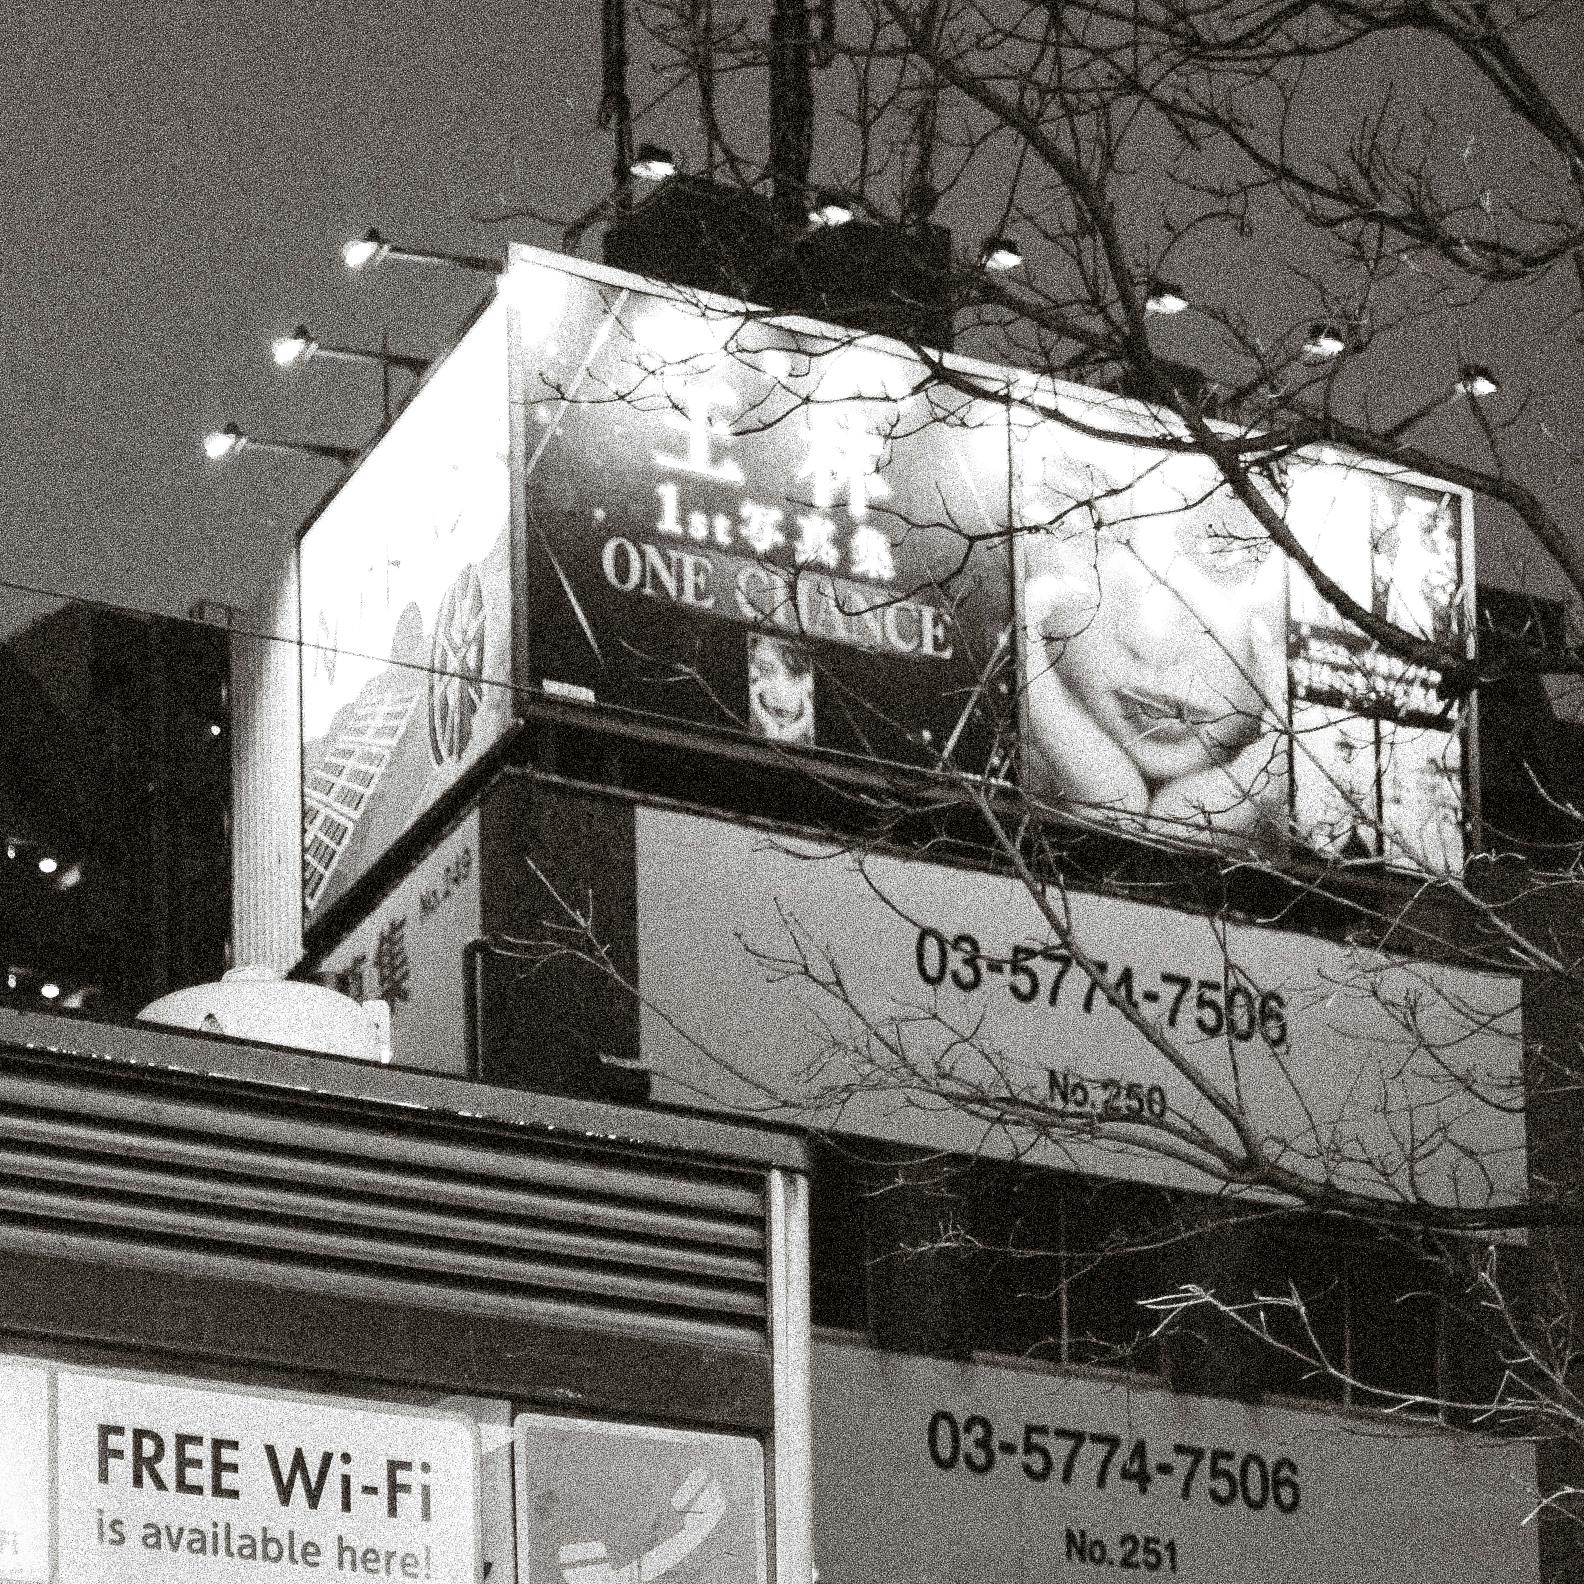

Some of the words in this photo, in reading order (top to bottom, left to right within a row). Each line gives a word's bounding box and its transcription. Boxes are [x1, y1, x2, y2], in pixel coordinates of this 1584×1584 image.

[601, 535, 716, 608] ONE
[915, 926, 1289, 1049] 03-5774-7506
[96, 1422, 241, 1501] FREE
[263, 1442, 433, 1523] Wi-Fi
[927, 1409, 1302, 1515] 03-5774-7506
[96, 1507, 127, 1548] is
[140, 1519, 323, 1569] available
[336, 1533, 433, 1581] here!
[1064, 1526, 1179, 1574] No.251
